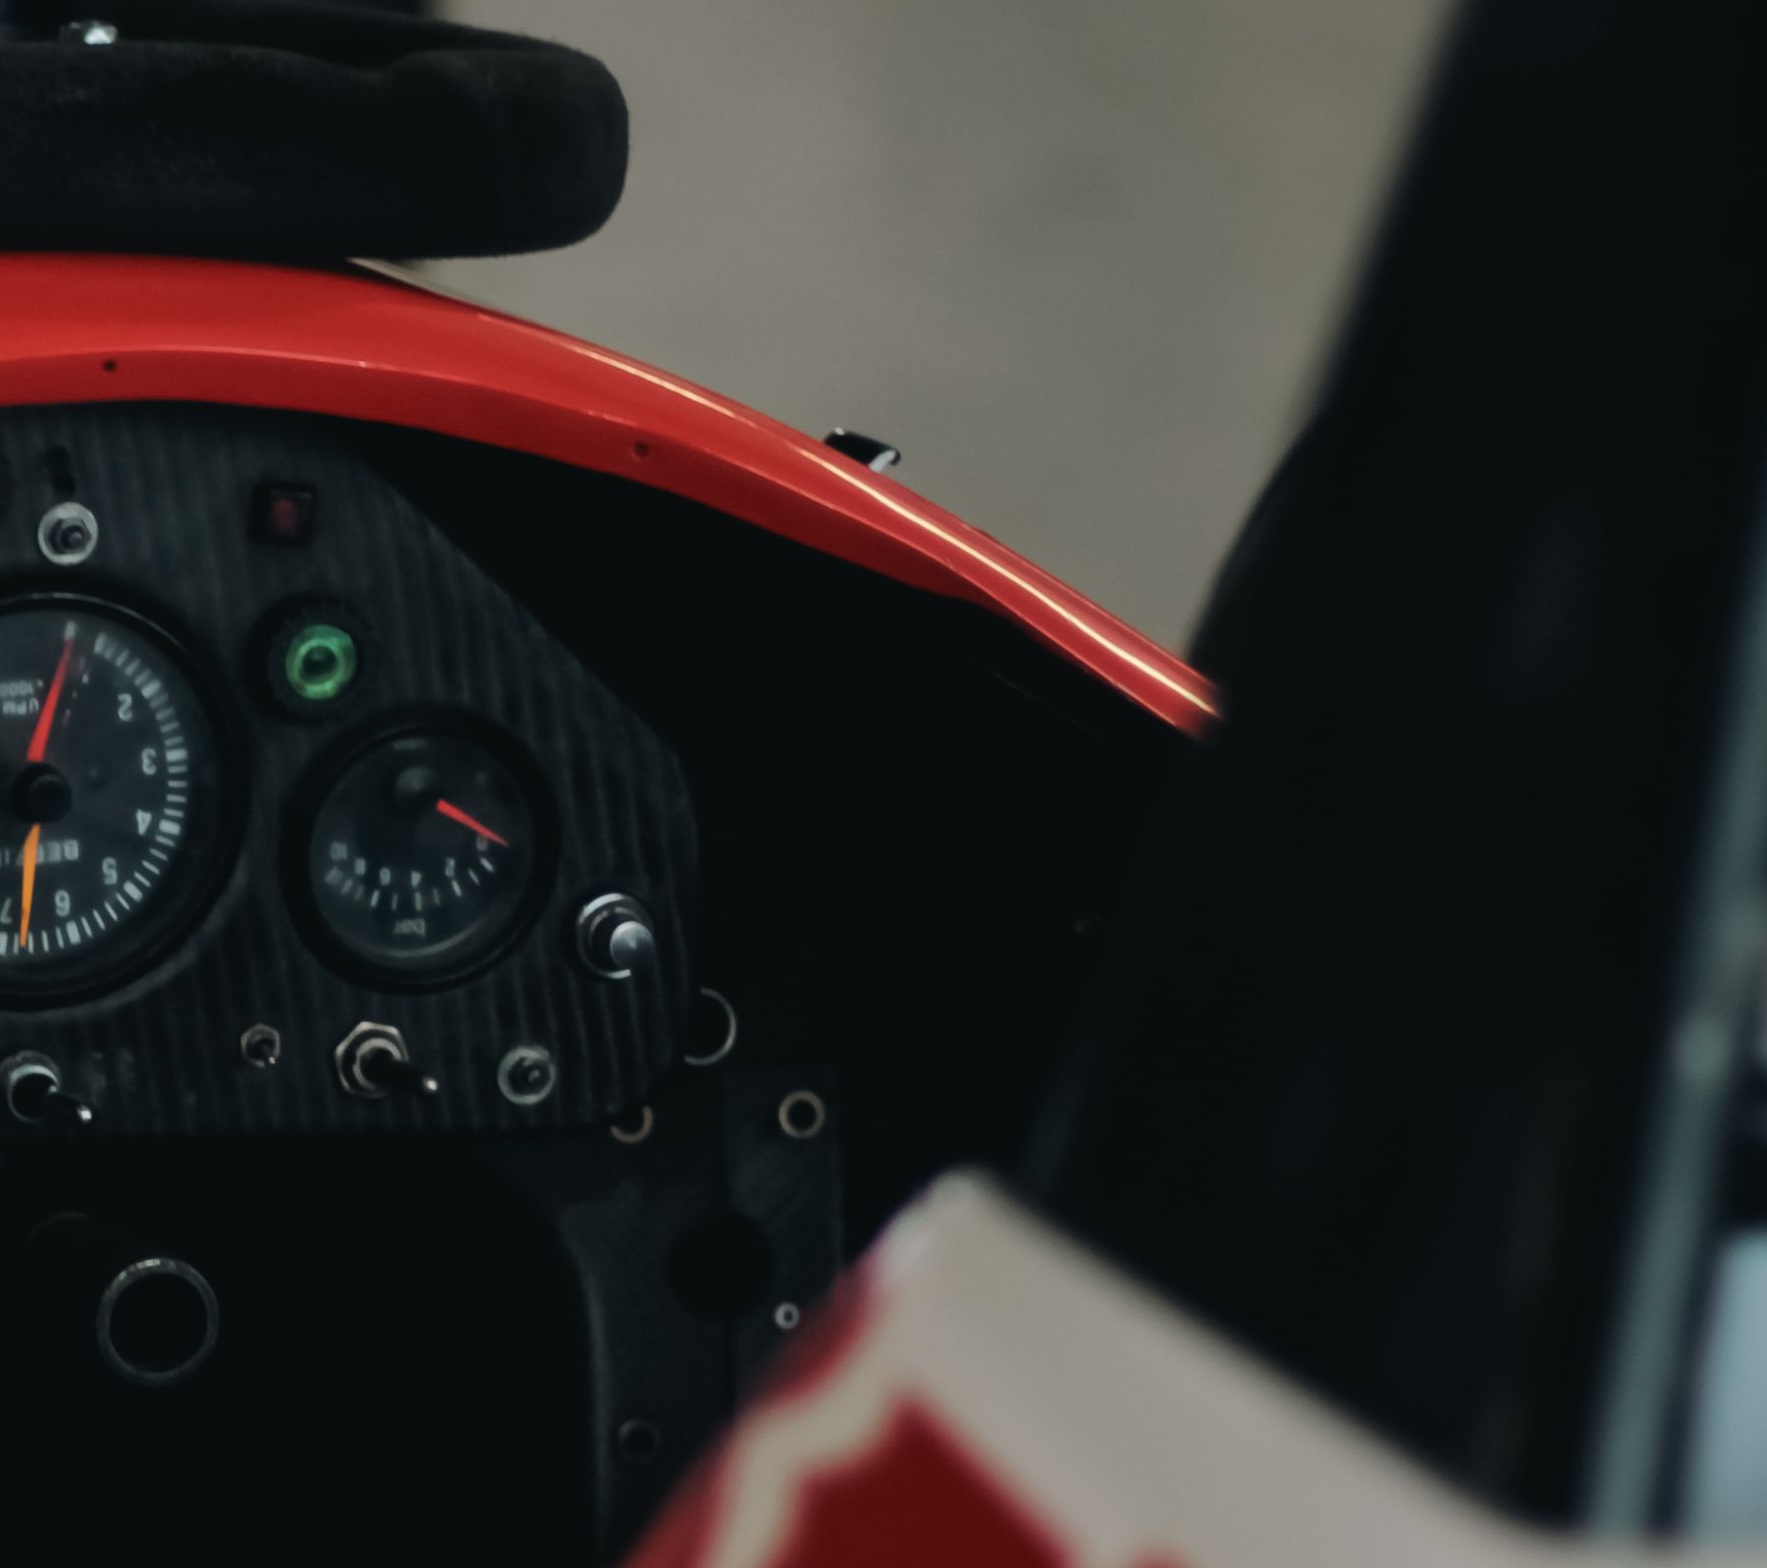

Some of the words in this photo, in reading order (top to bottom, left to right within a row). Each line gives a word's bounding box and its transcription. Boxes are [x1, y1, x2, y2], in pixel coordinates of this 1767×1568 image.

[2, 699, 39, 716] UPM
[117, 694, 133, 721] 2
[141, 748, 157, 775] 3
[135, 809, 152, 835] 4
[102, 857, 118, 884] 5
[410, 871, 422, 889] 4
[444, 857, 456, 878] 2
[0, 897, 13, 924] 7
[54, 889, 71, 916] 6
[391, 917, 427, 937] bar
